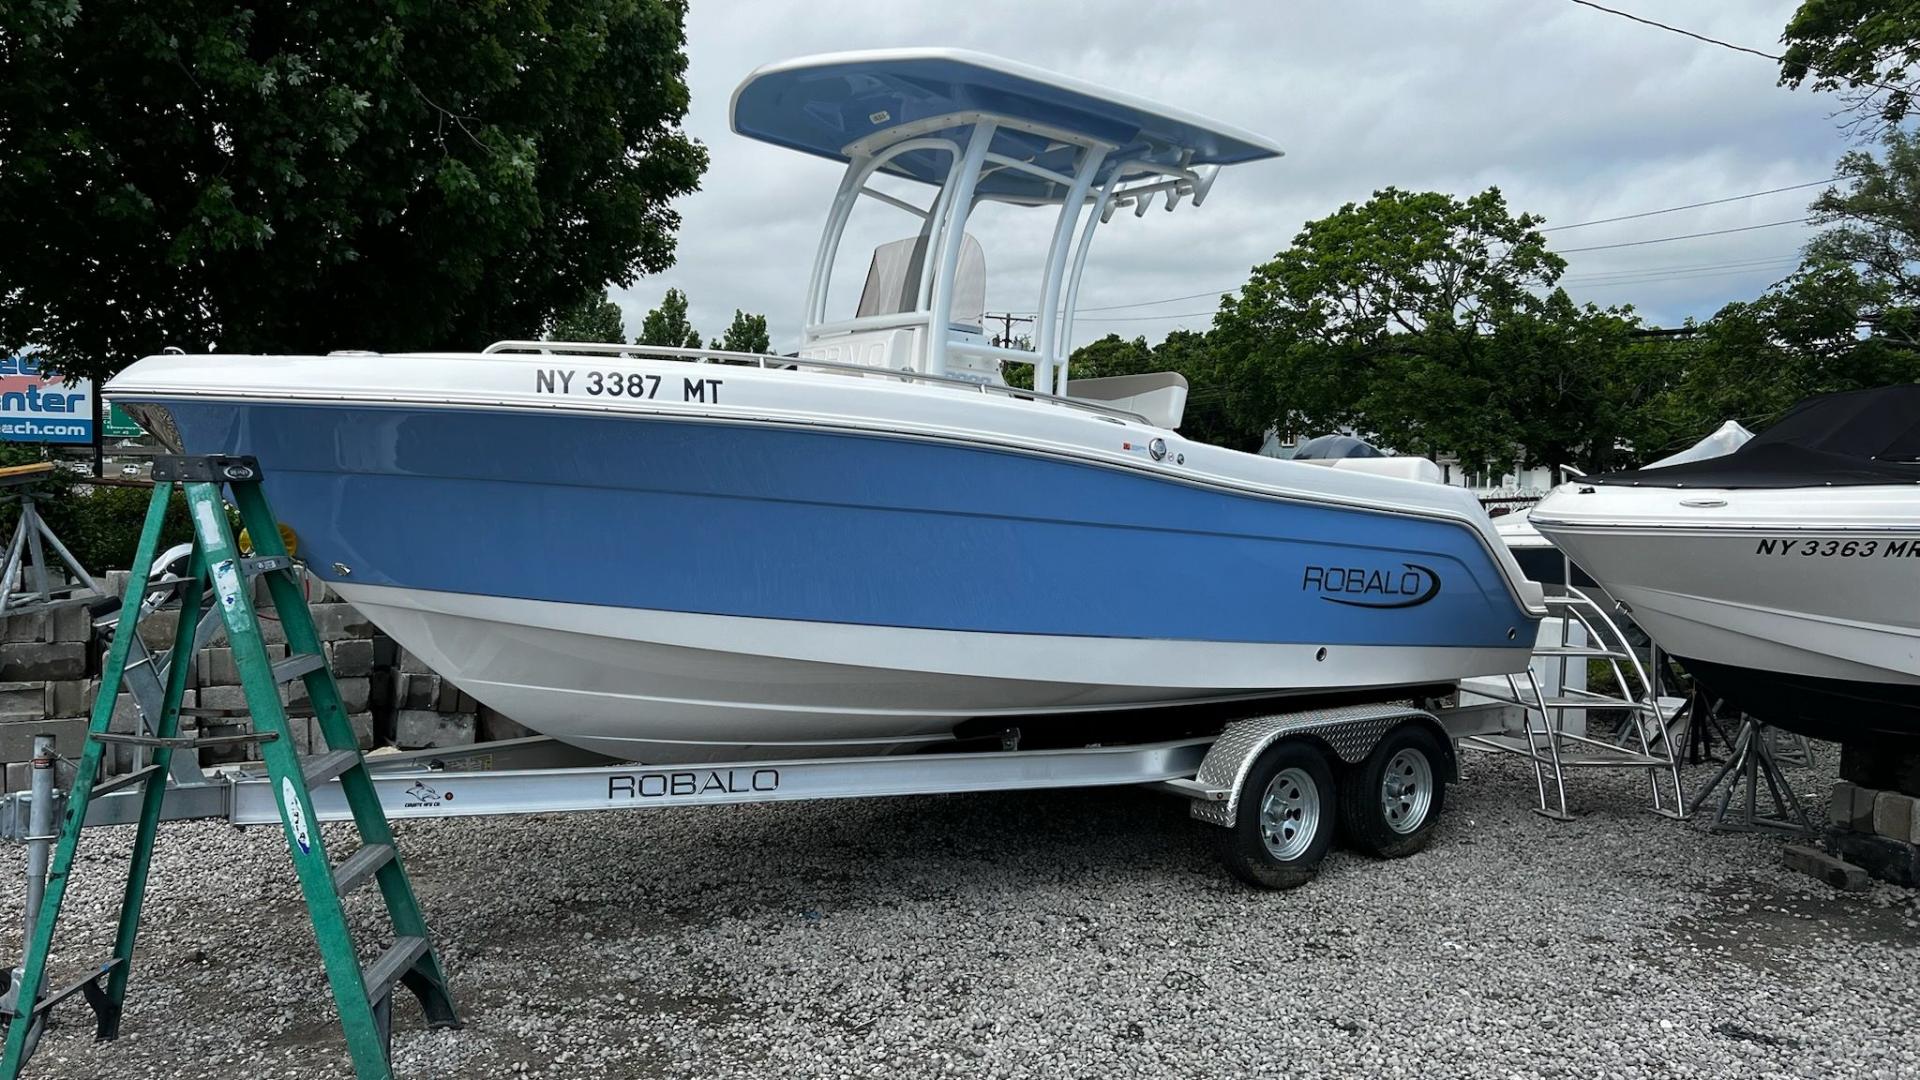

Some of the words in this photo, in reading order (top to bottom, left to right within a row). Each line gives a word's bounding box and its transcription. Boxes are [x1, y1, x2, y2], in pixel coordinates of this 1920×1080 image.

[0, 384, 85, 413] nter
[536, 369, 575, 394] NY
[585, 371, 661, 399] 3387
[683, 377, 723, 404] MT
[1756, 539, 1799, 555] NY
[1800, 540, 1878, 557] 3363
[1883, 541, 1920, 558] MR
[1302, 566, 1420, 595] ROBALO
[608, 769, 779, 799] ROBALO
